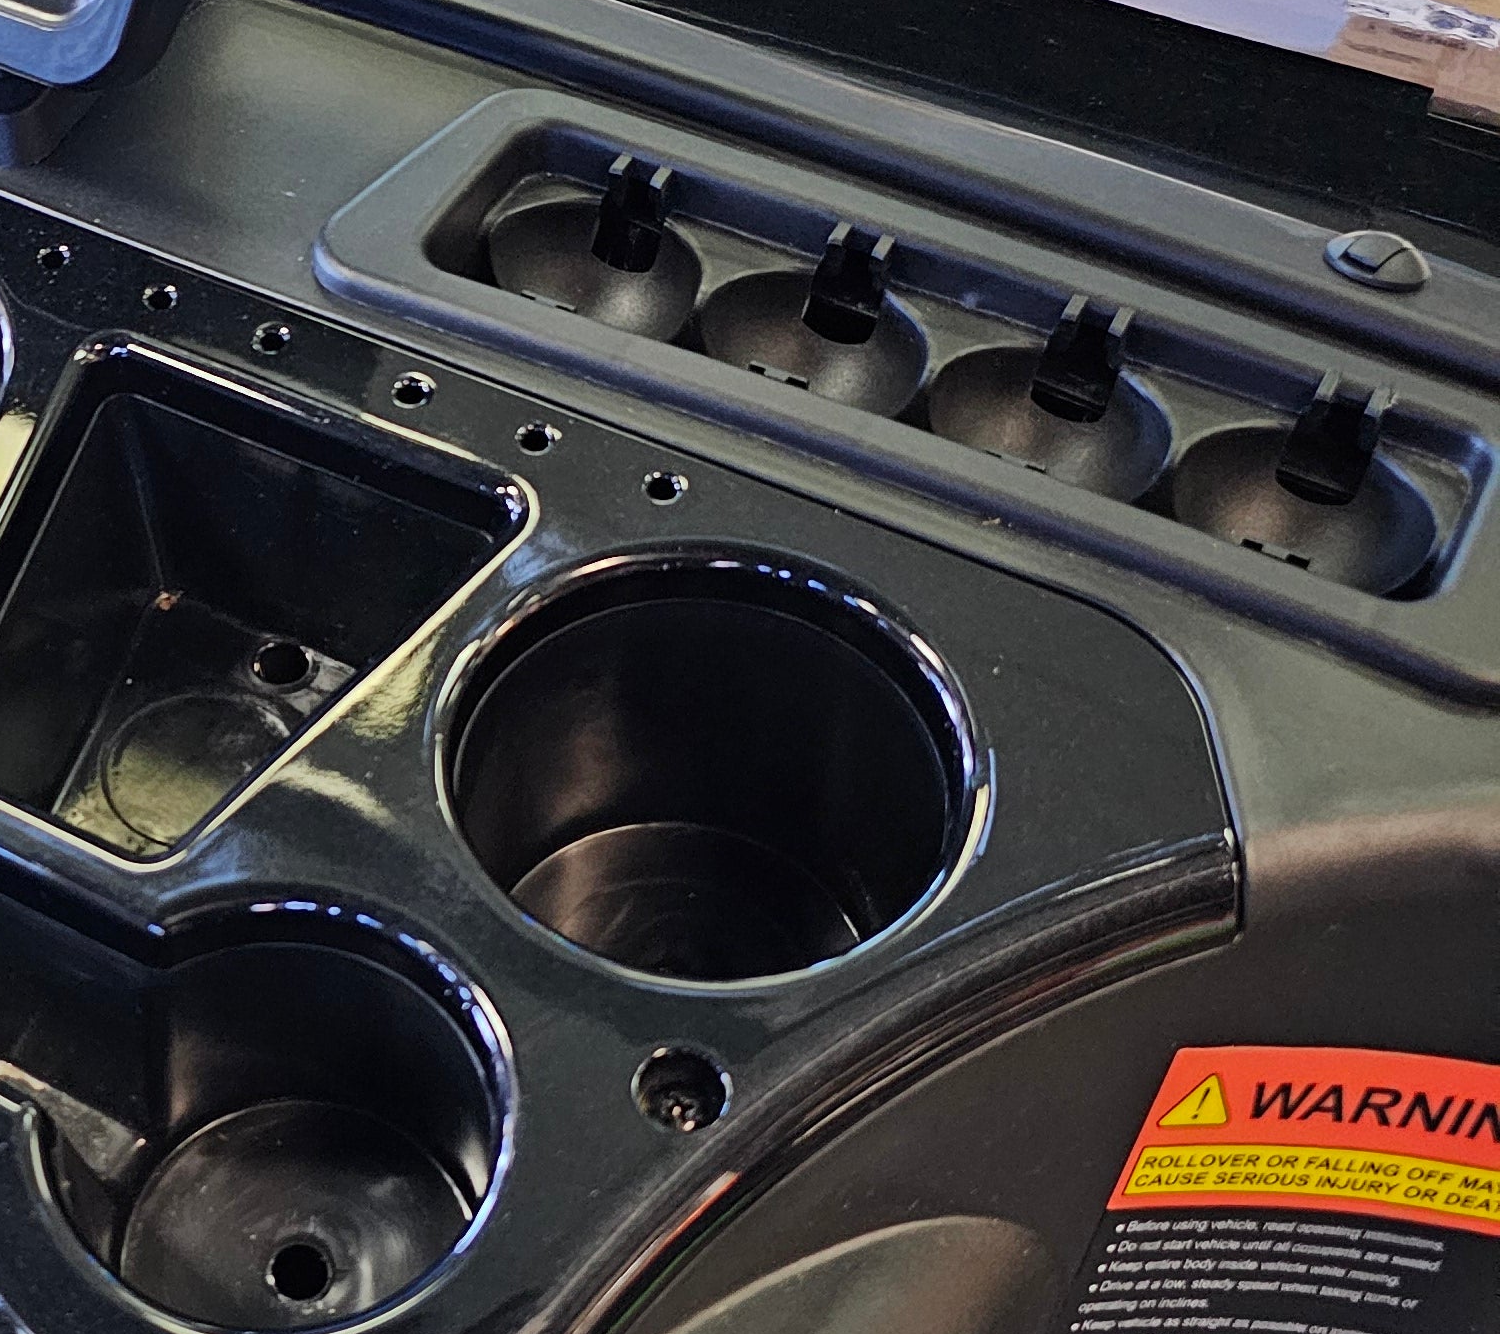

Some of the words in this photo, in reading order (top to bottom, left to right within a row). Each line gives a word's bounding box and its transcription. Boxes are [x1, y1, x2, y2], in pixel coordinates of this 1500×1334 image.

[1141, 1152, 1261, 1170] ROLLOVER
[1265, 1154, 1299, 1170] OR
[1303, 1155, 1400, 1177] FALLING
[1407, 1166, 1455, 1185] OFF
[1134, 1171, 1206, 1187] CAUSE
[1212, 1172, 1310, 1188] SERIOUS
[1315, 1175, 1400, 1195] INJURY
[1403, 1185, 1438, 1203] OR
[1172, 1219, 1208, 1233] using
[1118, 1240, 1137, 1254] Do
[1162, 1239, 1192, 1251] start
[1195, 1239, 1240, 1251] vehicle
[1242, 1240, 1272, 1251] until
[1184, 1258, 1216, 1271] body
[1190, 1279, 1236, 1291] steady
[1402, 1299, 1419, 1309] or
[1139, 1299, 1156, 1309] on
[1158, 1297, 1208, 1309] inclines.
